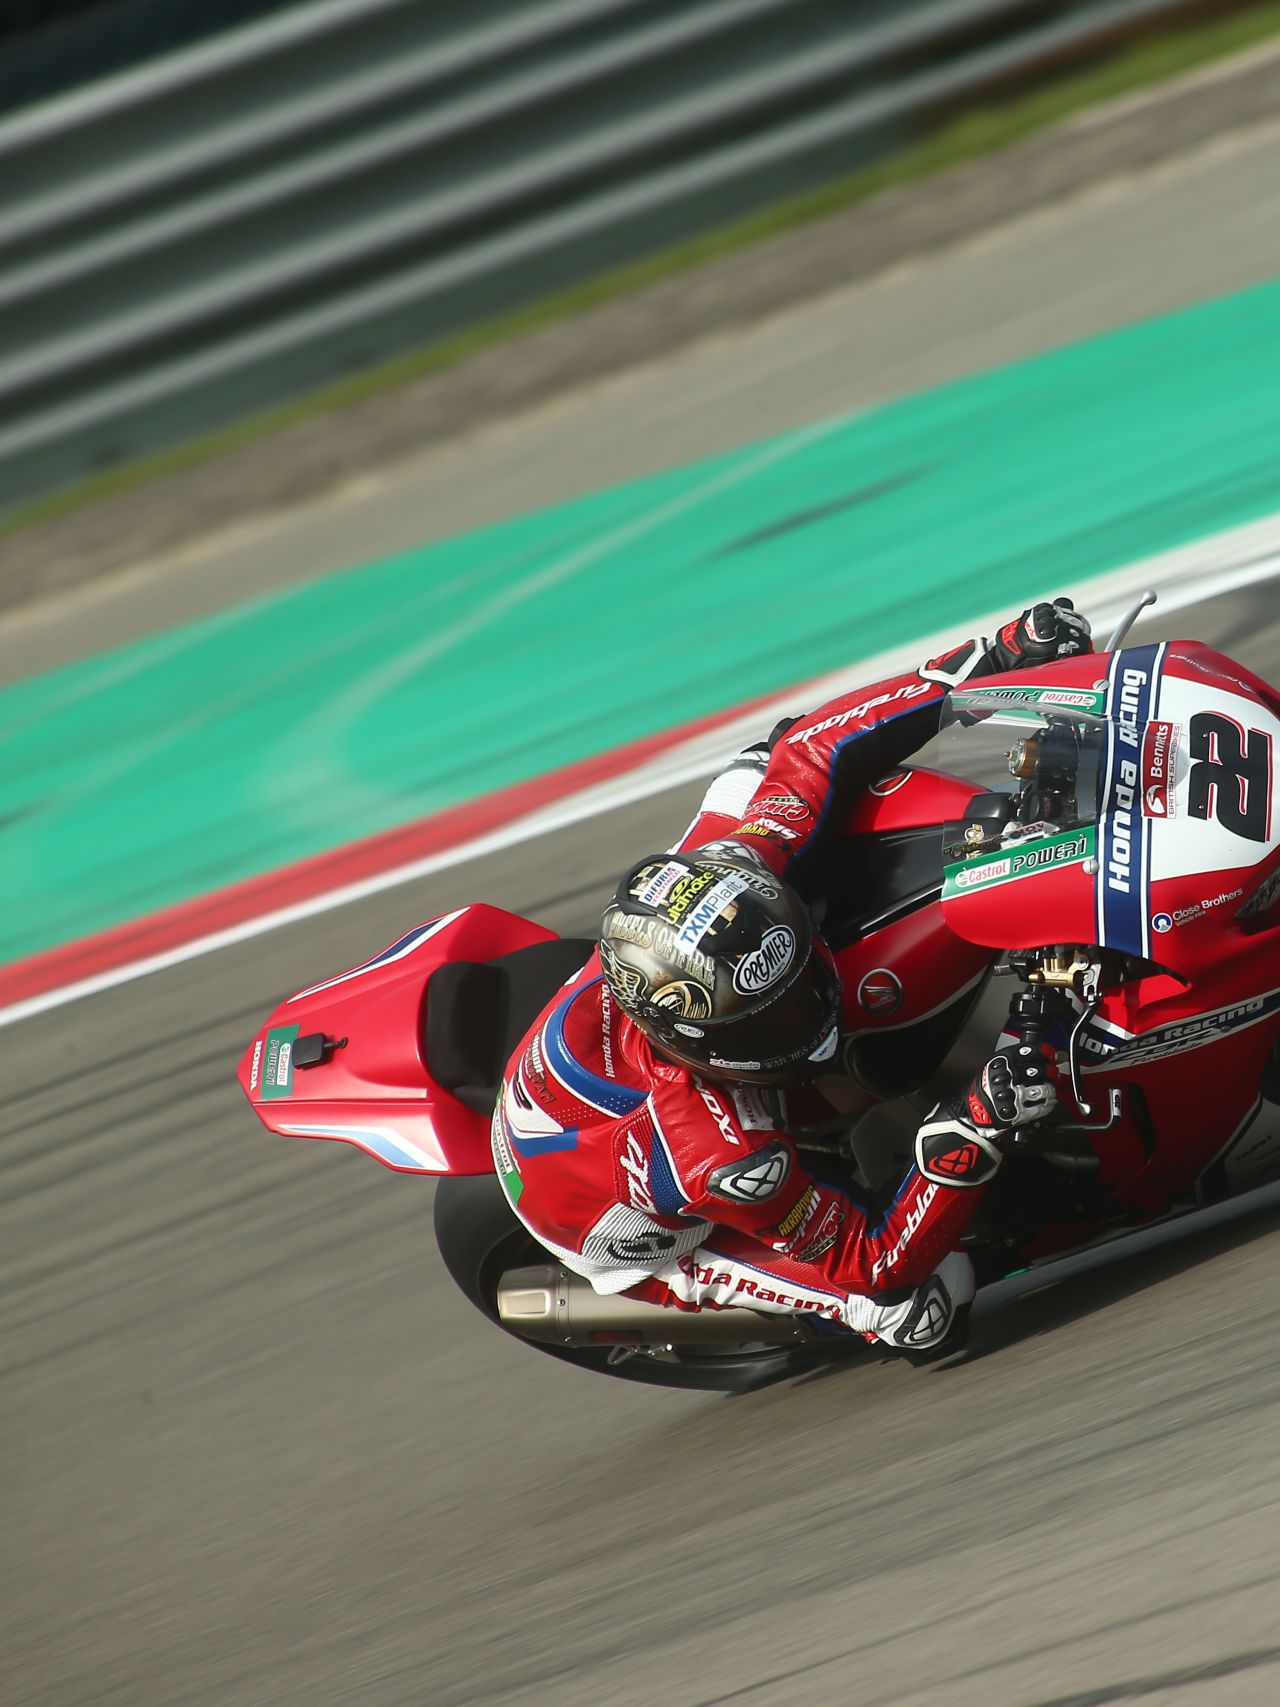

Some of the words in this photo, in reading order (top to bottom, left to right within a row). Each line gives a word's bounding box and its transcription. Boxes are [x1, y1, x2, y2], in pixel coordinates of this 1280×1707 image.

[785, 682, 932, 744] Fireblade
[1044, 691, 1080, 705] Castrol
[1150, 724, 1168, 778] Benntts
[1187, 710, 1273, 843] 22
[1109, 759, 1137, 893] Honda
[968, 861, 1007, 883] Castrol
[1013, 833, 1087, 872] POWER1
[667, 871, 715, 925] ultimate
[680, 880, 743, 944] TXMPlant
[1172, 904, 1200, 921] Close
[1201, 887, 1243, 909] Brothers
[743, 933, 792, 988] PREMIER
[1164, 997, 1264, 1039] Racing
[250, 1040, 263, 1092] HONDA
[278, 1053, 288, 1083] Castrol
[602, 1036, 616, 1078] Honda
